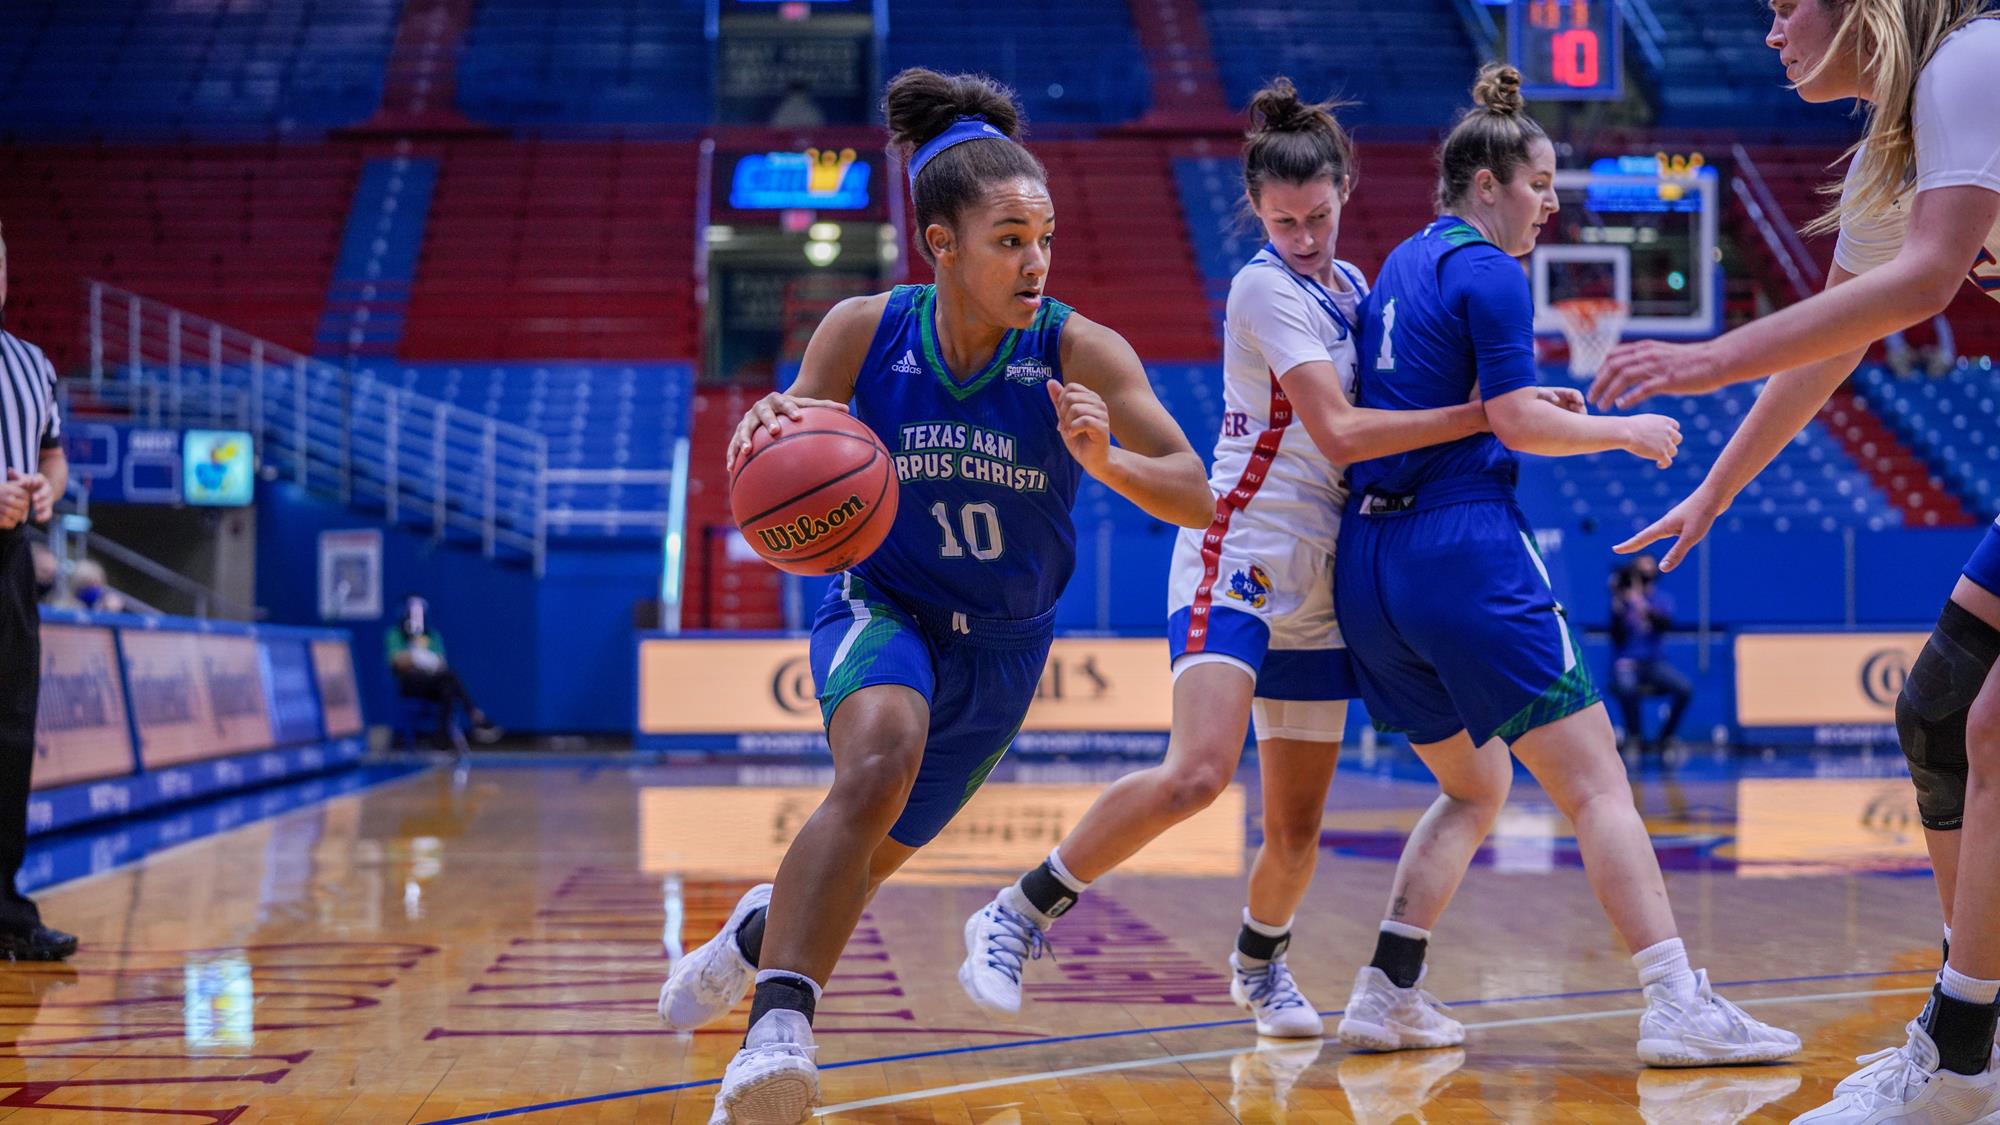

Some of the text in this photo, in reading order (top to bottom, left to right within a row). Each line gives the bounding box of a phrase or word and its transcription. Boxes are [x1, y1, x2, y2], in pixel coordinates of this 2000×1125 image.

[1552, 29, 1598, 87] 10
[1376, 298, 1395, 369] 1
[1006, 365, 1052, 377] SOUTHLAND
[902, 424, 1014, 462] TEXAS A&M
[891, 452, 1046, 490] RPUS CHRISTI
[757, 494, 865, 552] Wilson
[931, 502, 1004, 560] 10
[1243, 580, 1257, 594] KU
